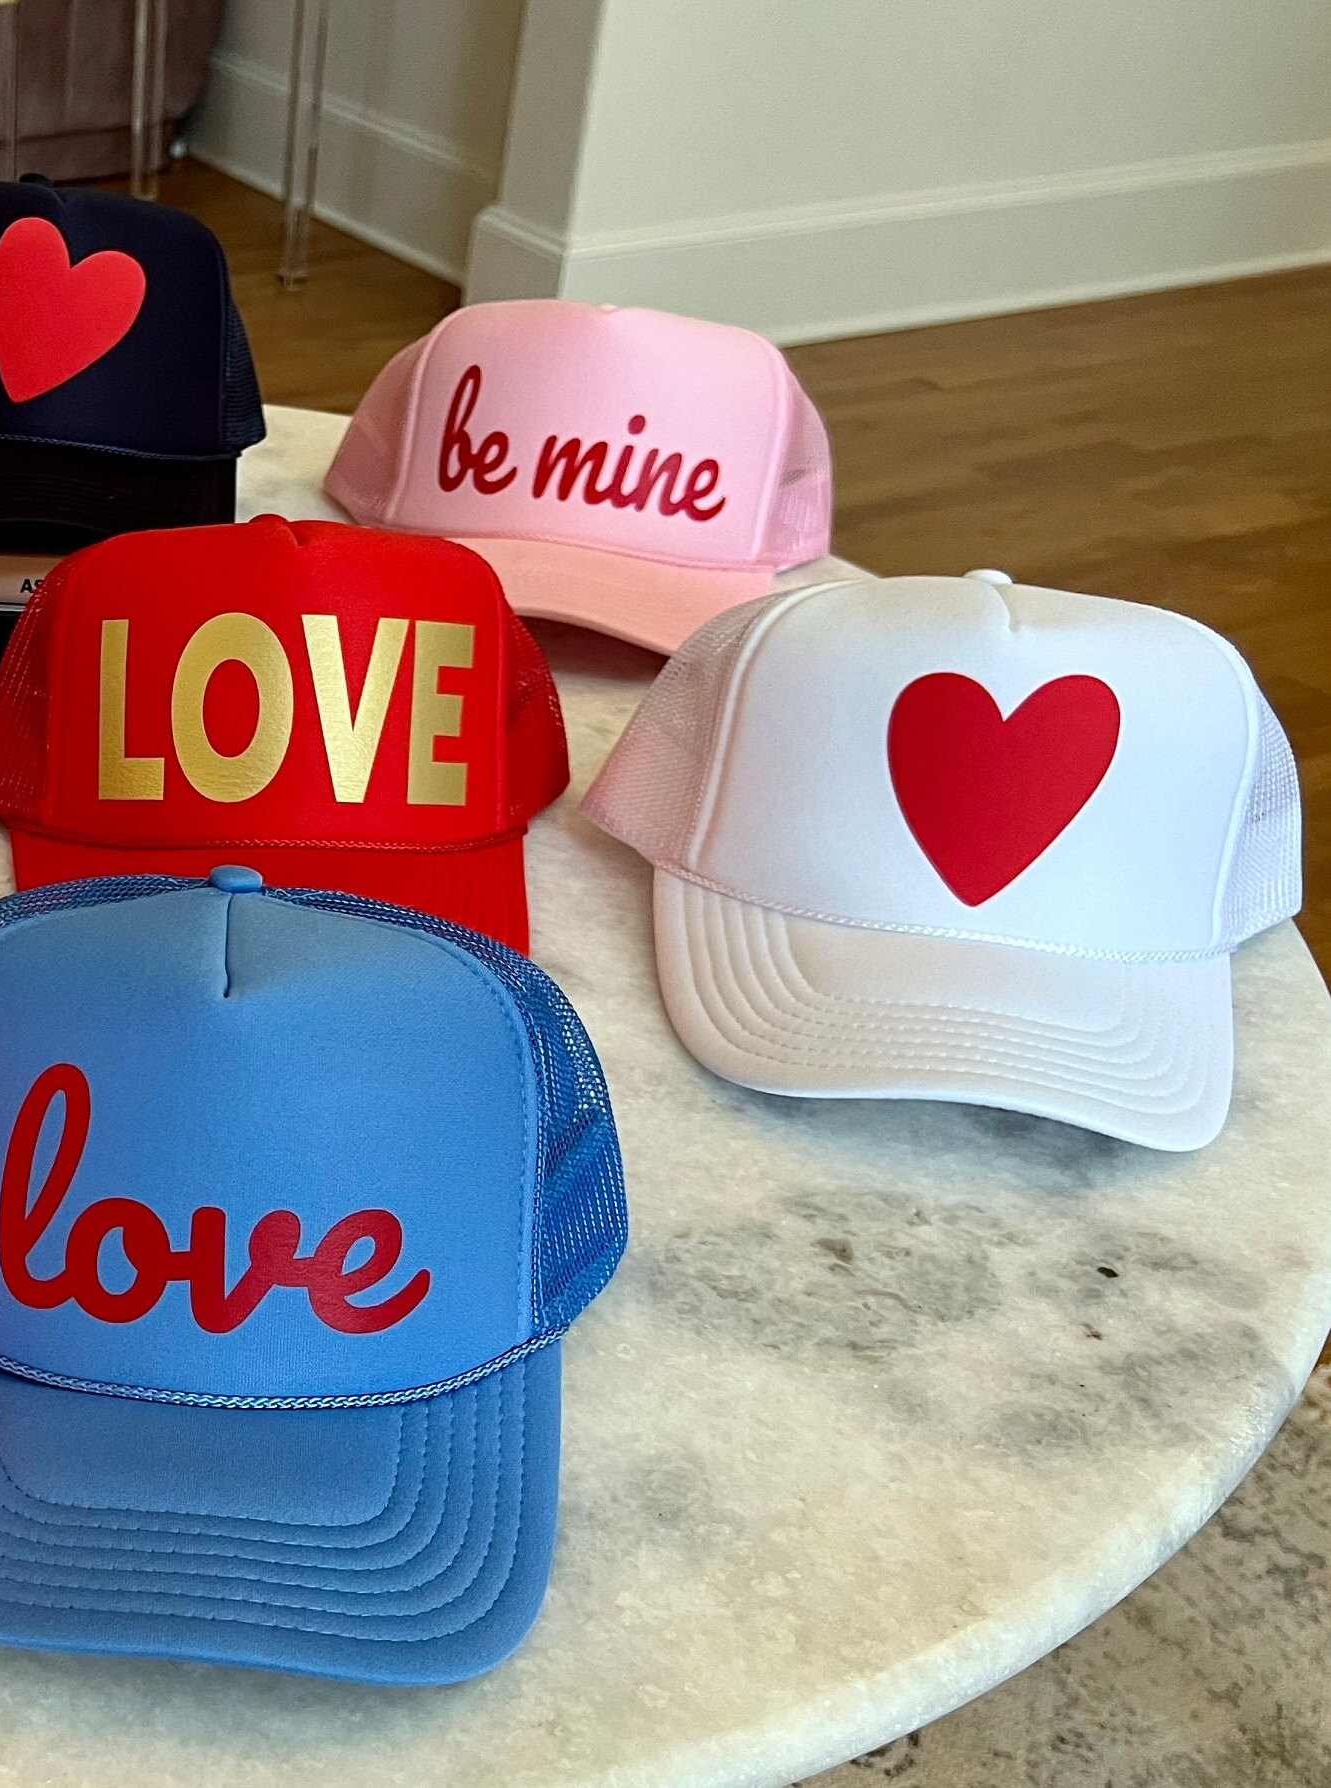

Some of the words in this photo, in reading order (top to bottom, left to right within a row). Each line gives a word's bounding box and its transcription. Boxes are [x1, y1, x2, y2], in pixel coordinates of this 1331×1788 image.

[437, 363, 518, 496] be
[533, 414, 728, 523] mine
[98, 612, 476, 806] LOVE
